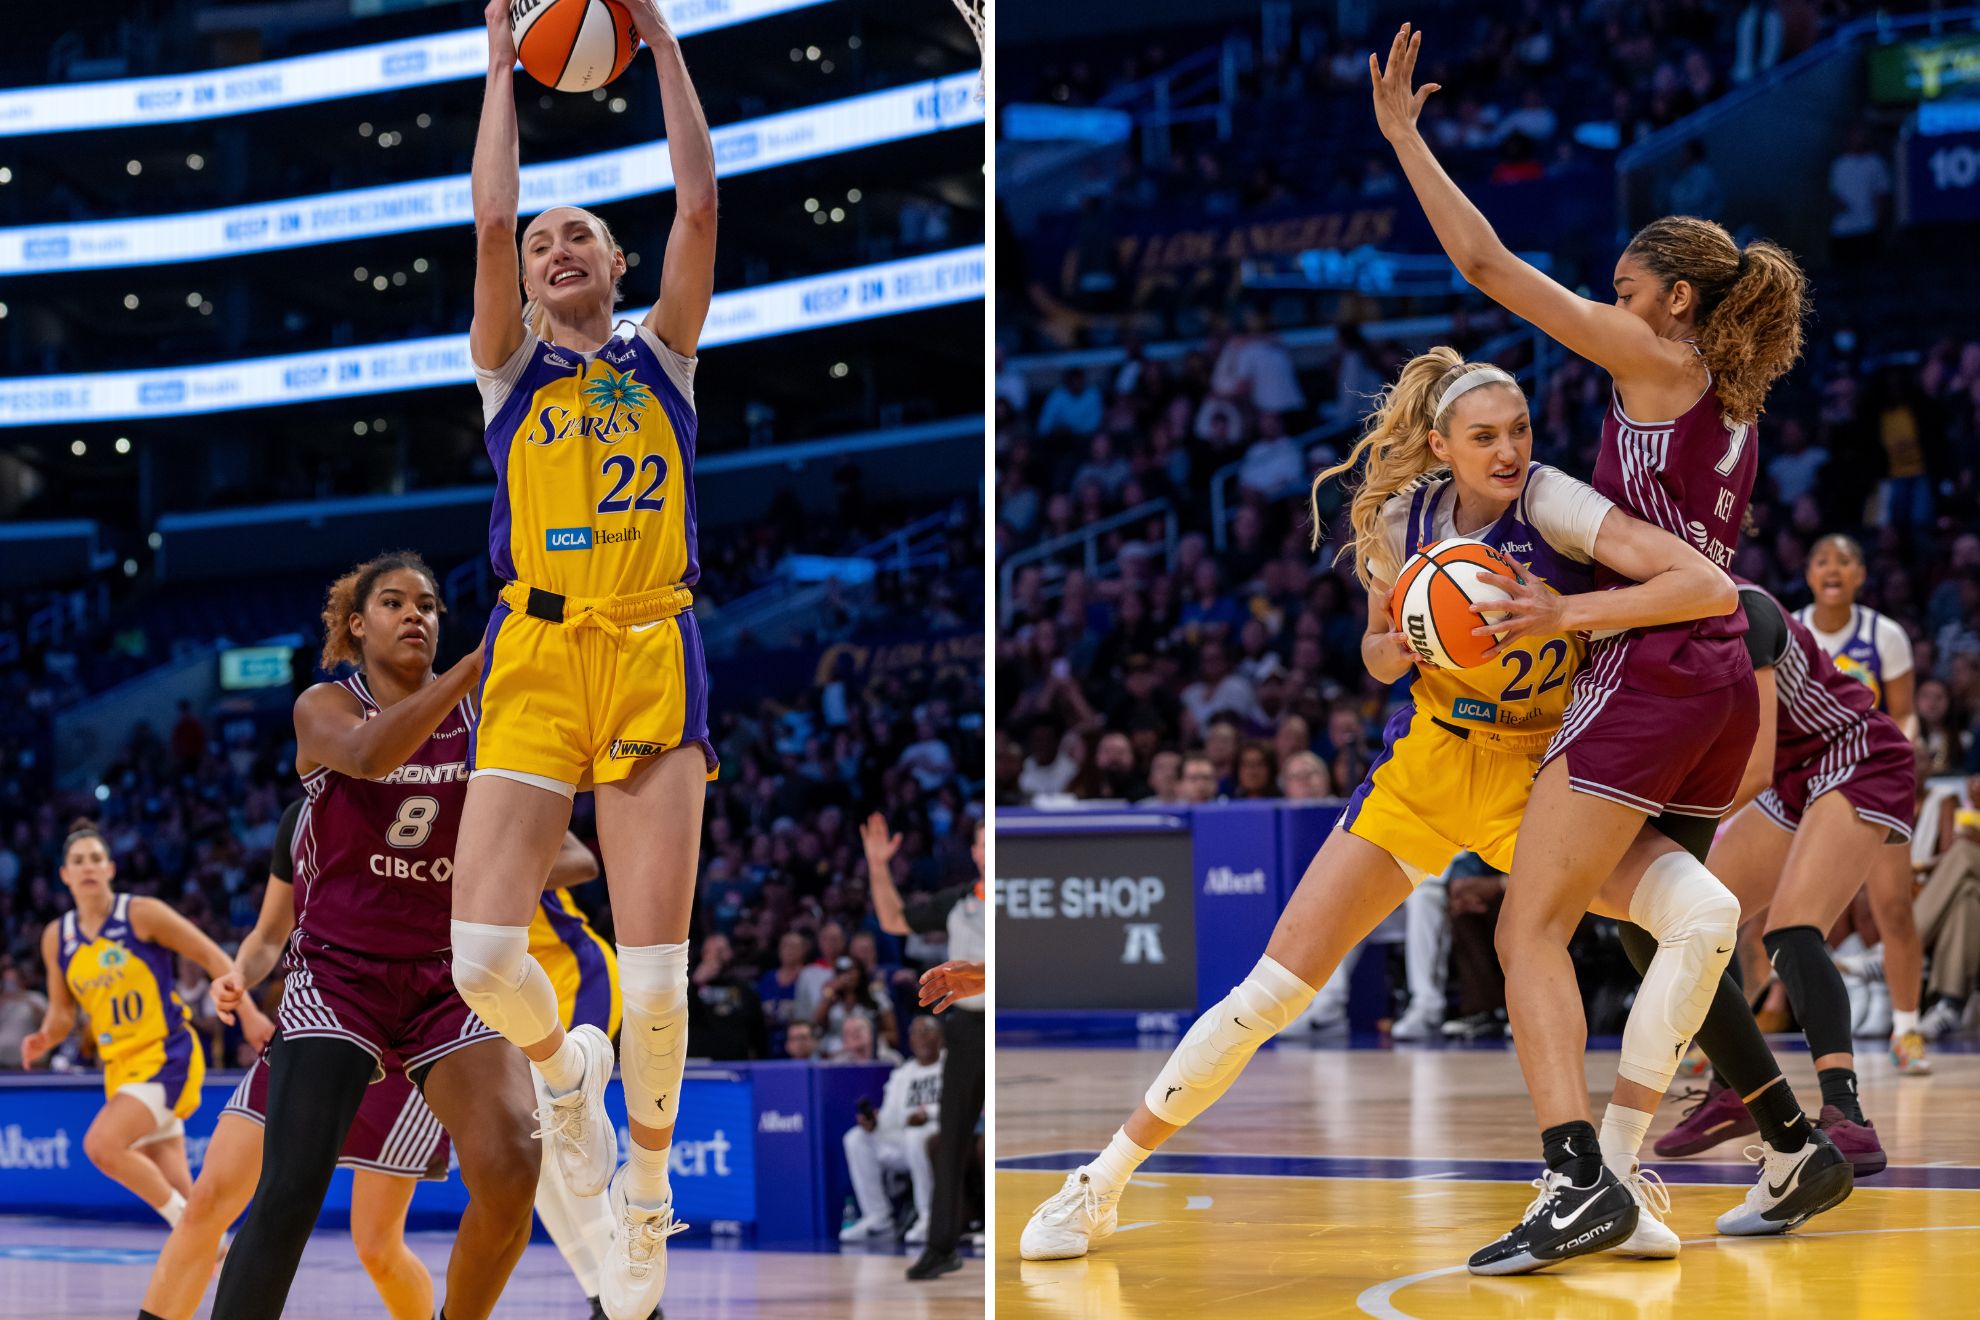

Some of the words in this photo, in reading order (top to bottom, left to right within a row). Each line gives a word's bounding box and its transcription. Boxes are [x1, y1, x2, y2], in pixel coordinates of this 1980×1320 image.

[1928, 147, 1980, 190] 10
[596, 454, 668, 514] 22
[1714, 487, 1736, 523] KEY
[552, 530, 586, 546] UCLA
[594, 527, 641, 545] Health
[1500, 541, 1533, 553] Albert
[1705, 537, 1735, 568] AT&T
[1407, 614, 1440, 666] Wil
[1499, 638, 1568, 702] 22
[1458, 703, 1491, 718] UCLA
[621, 744, 662, 756] WNBA
[372, 762, 469, 784] RONTO
[386, 796, 440, 848] 8
[370, 854, 427, 881] CIBC
[1203, 867, 1266, 895] Albert
[1060, 877, 1165, 919] SHOP
[111, 990, 144, 1025] 10
